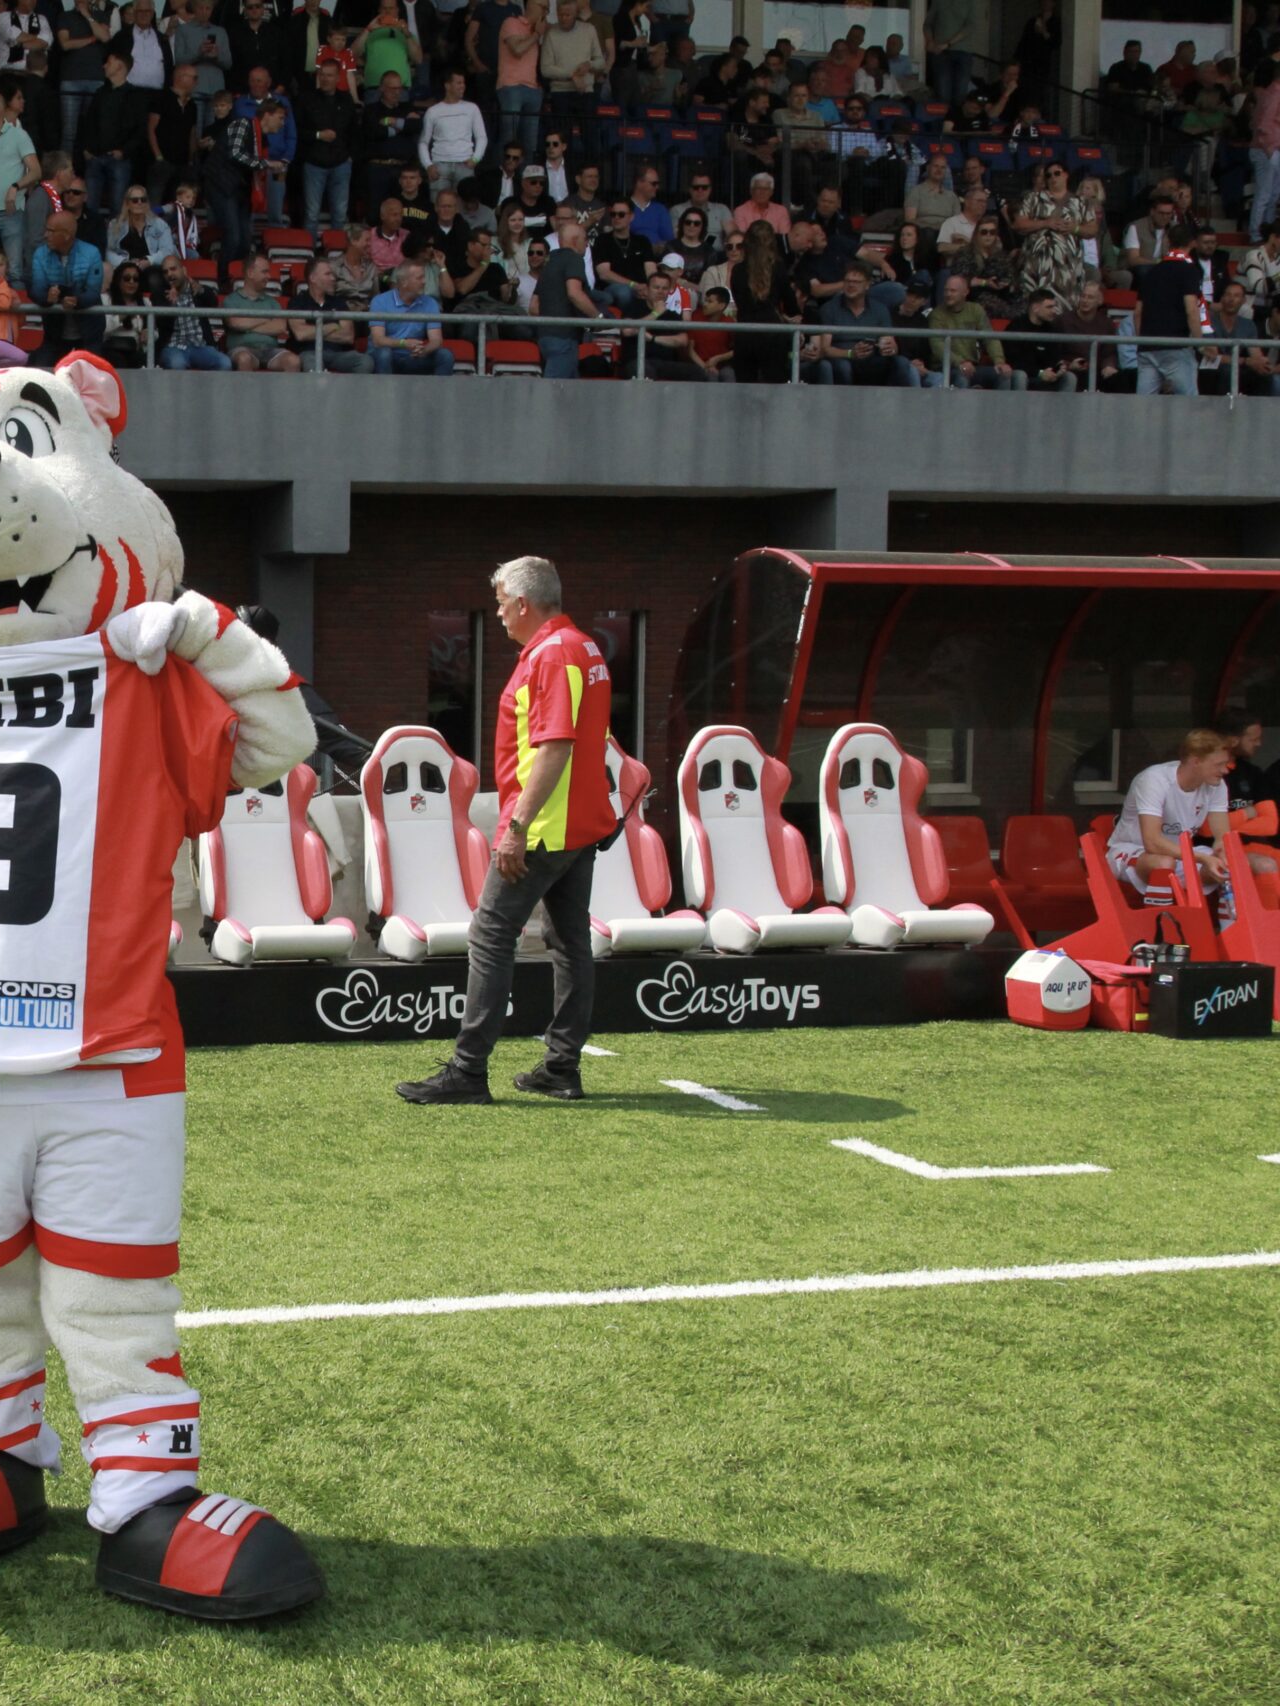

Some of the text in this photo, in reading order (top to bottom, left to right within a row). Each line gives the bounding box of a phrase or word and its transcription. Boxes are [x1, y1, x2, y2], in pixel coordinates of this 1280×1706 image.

[340, 981, 514, 1033] EasyTo
[658, 972, 820, 1024] EasyToys
[1193, 980, 1259, 1025] EXTRAN
